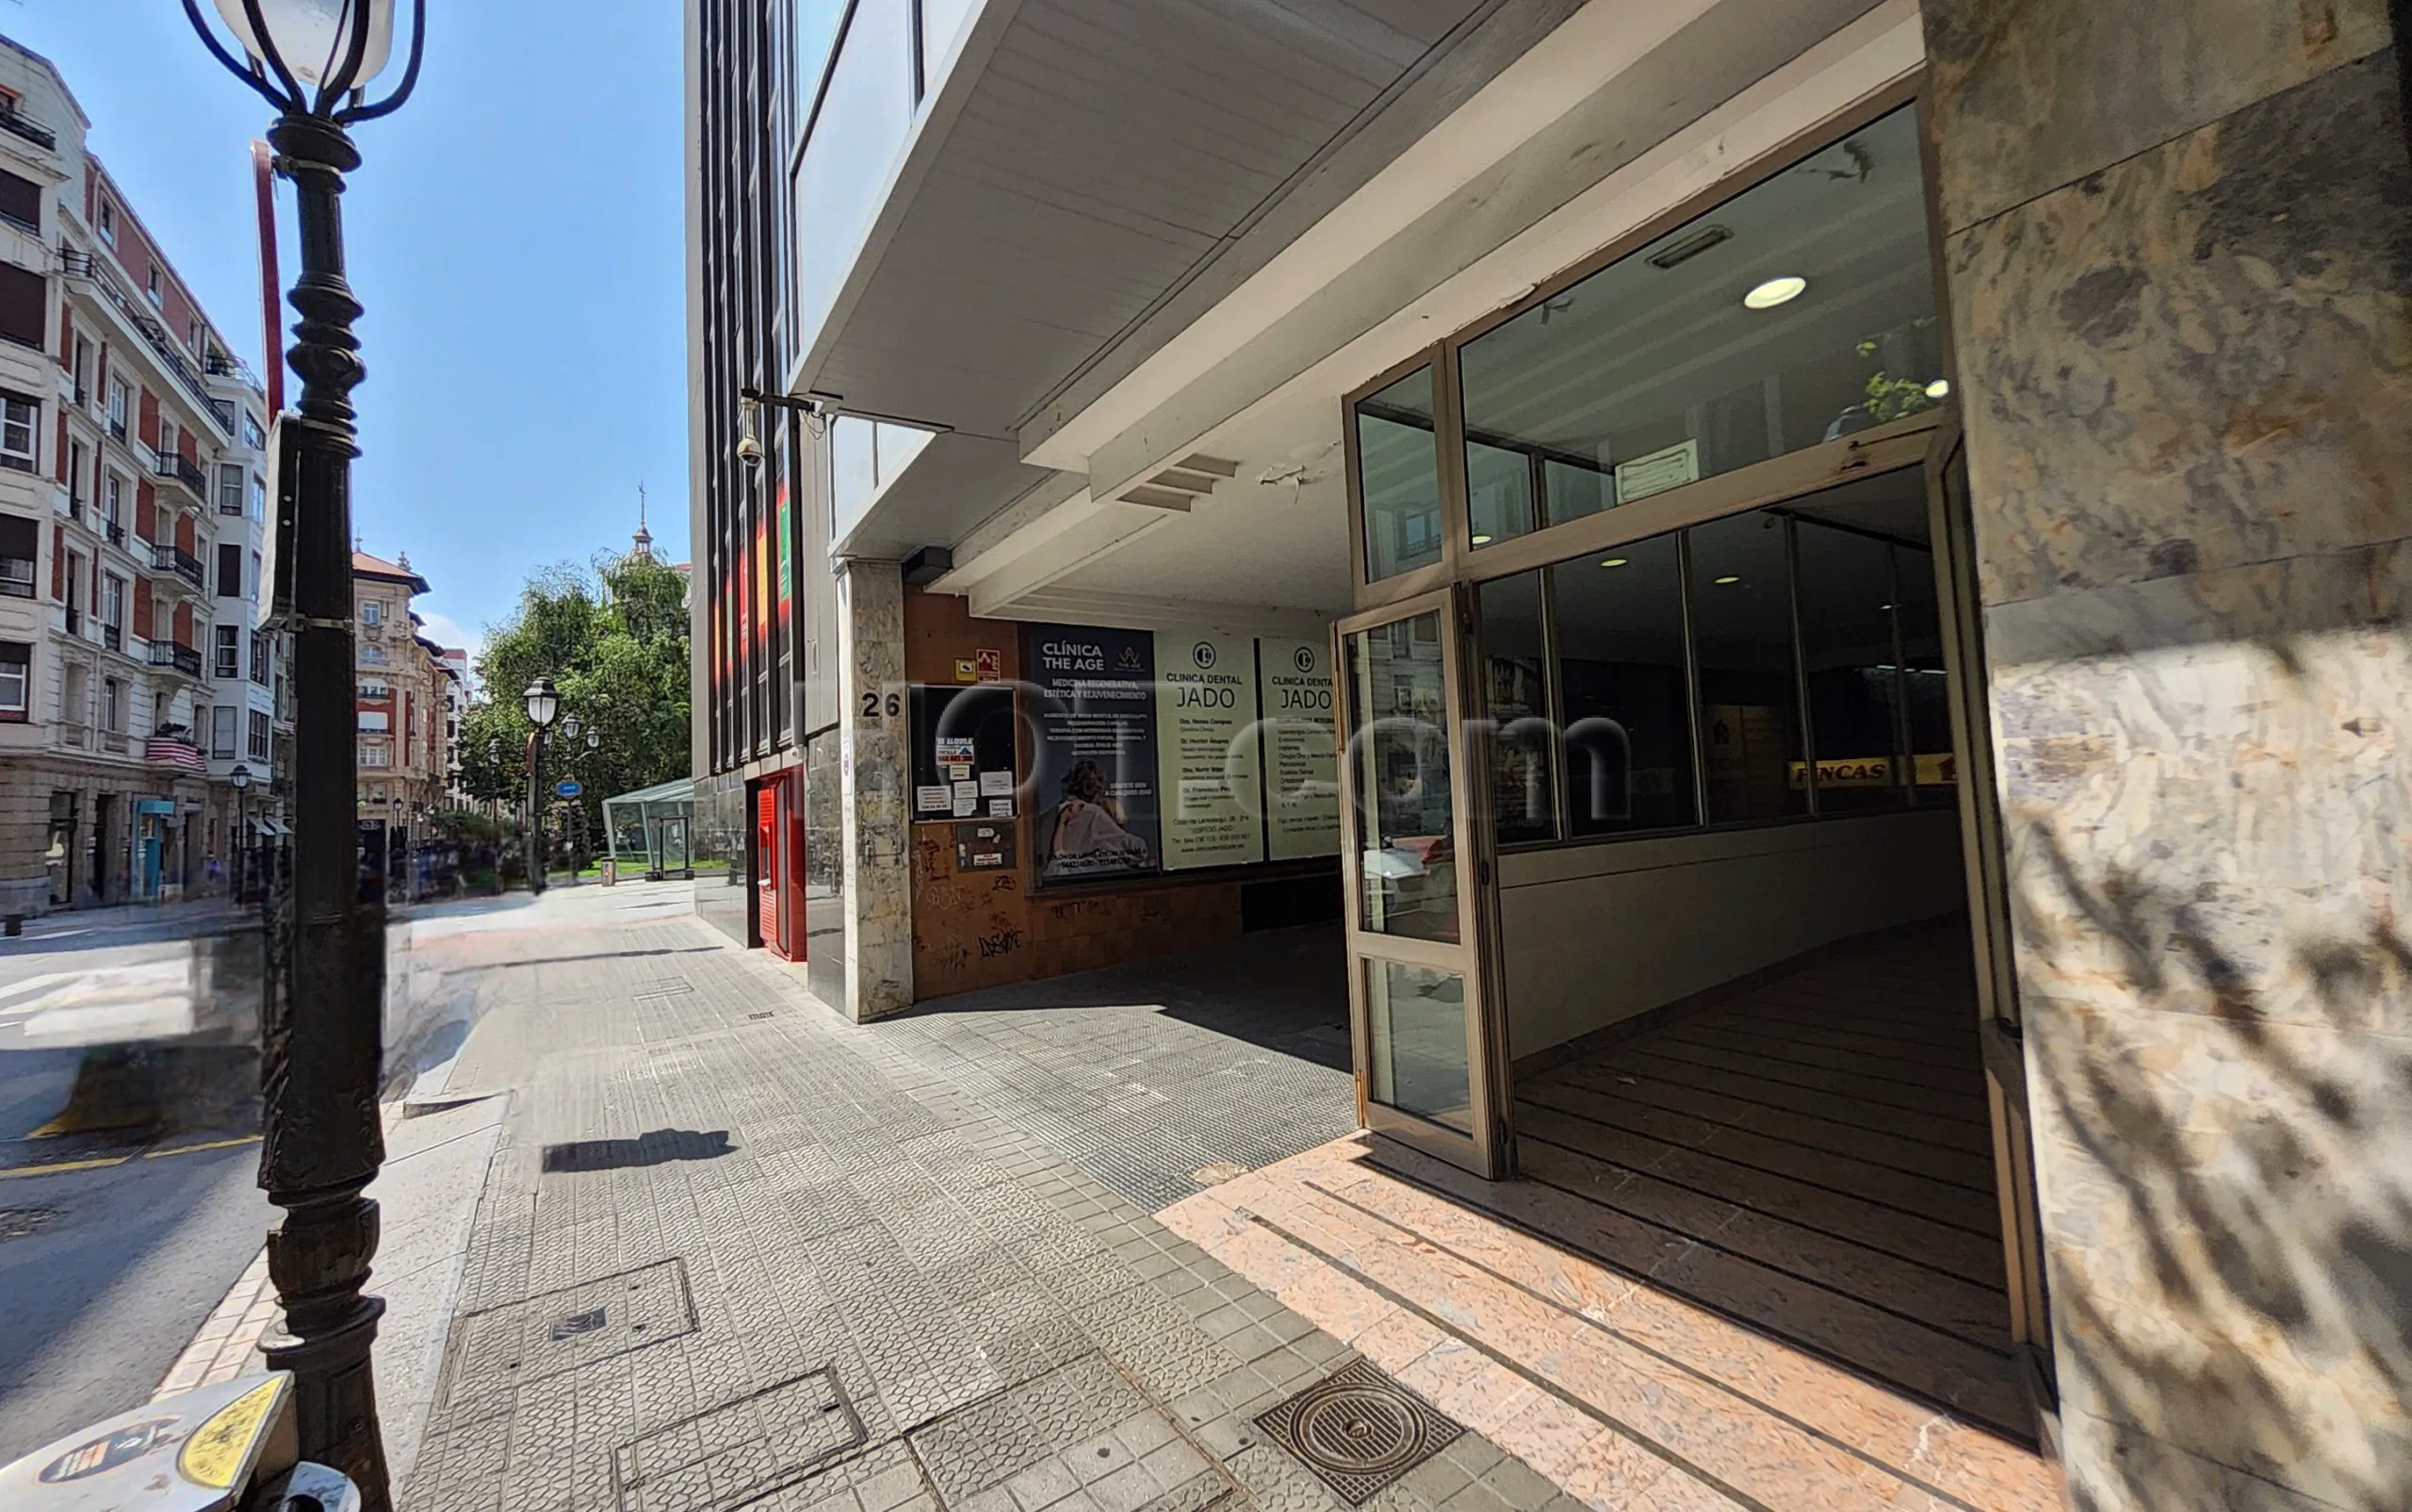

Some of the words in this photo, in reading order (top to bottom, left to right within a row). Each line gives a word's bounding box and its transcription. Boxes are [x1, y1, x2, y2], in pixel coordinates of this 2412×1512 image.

[1042, 640, 1103, 658] CLÍNICA
[1042, 657, 1071, 670] THE
[1073, 658, 1104, 671] AGE
[1051, 677, 1086, 689] MEDICINA
[1166, 673, 1205, 684] CLINICA
[1207, 674, 1243, 685] DENTAL
[1272, 675, 1305, 687] CLINICA
[1307, 677, 1333, 688] DENTA
[1043, 688, 1075, 698] ESTÉTICA
[1076, 690, 1083, 698] Y
[1083, 690, 1148, 700] REJUVENECIMIENTO
[1177, 686, 1235, 708] JADO
[1280, 689, 1332, 710] JADO
[861, 692, 901, 718] 26
[1796, 763, 1886, 783] FNCAS
